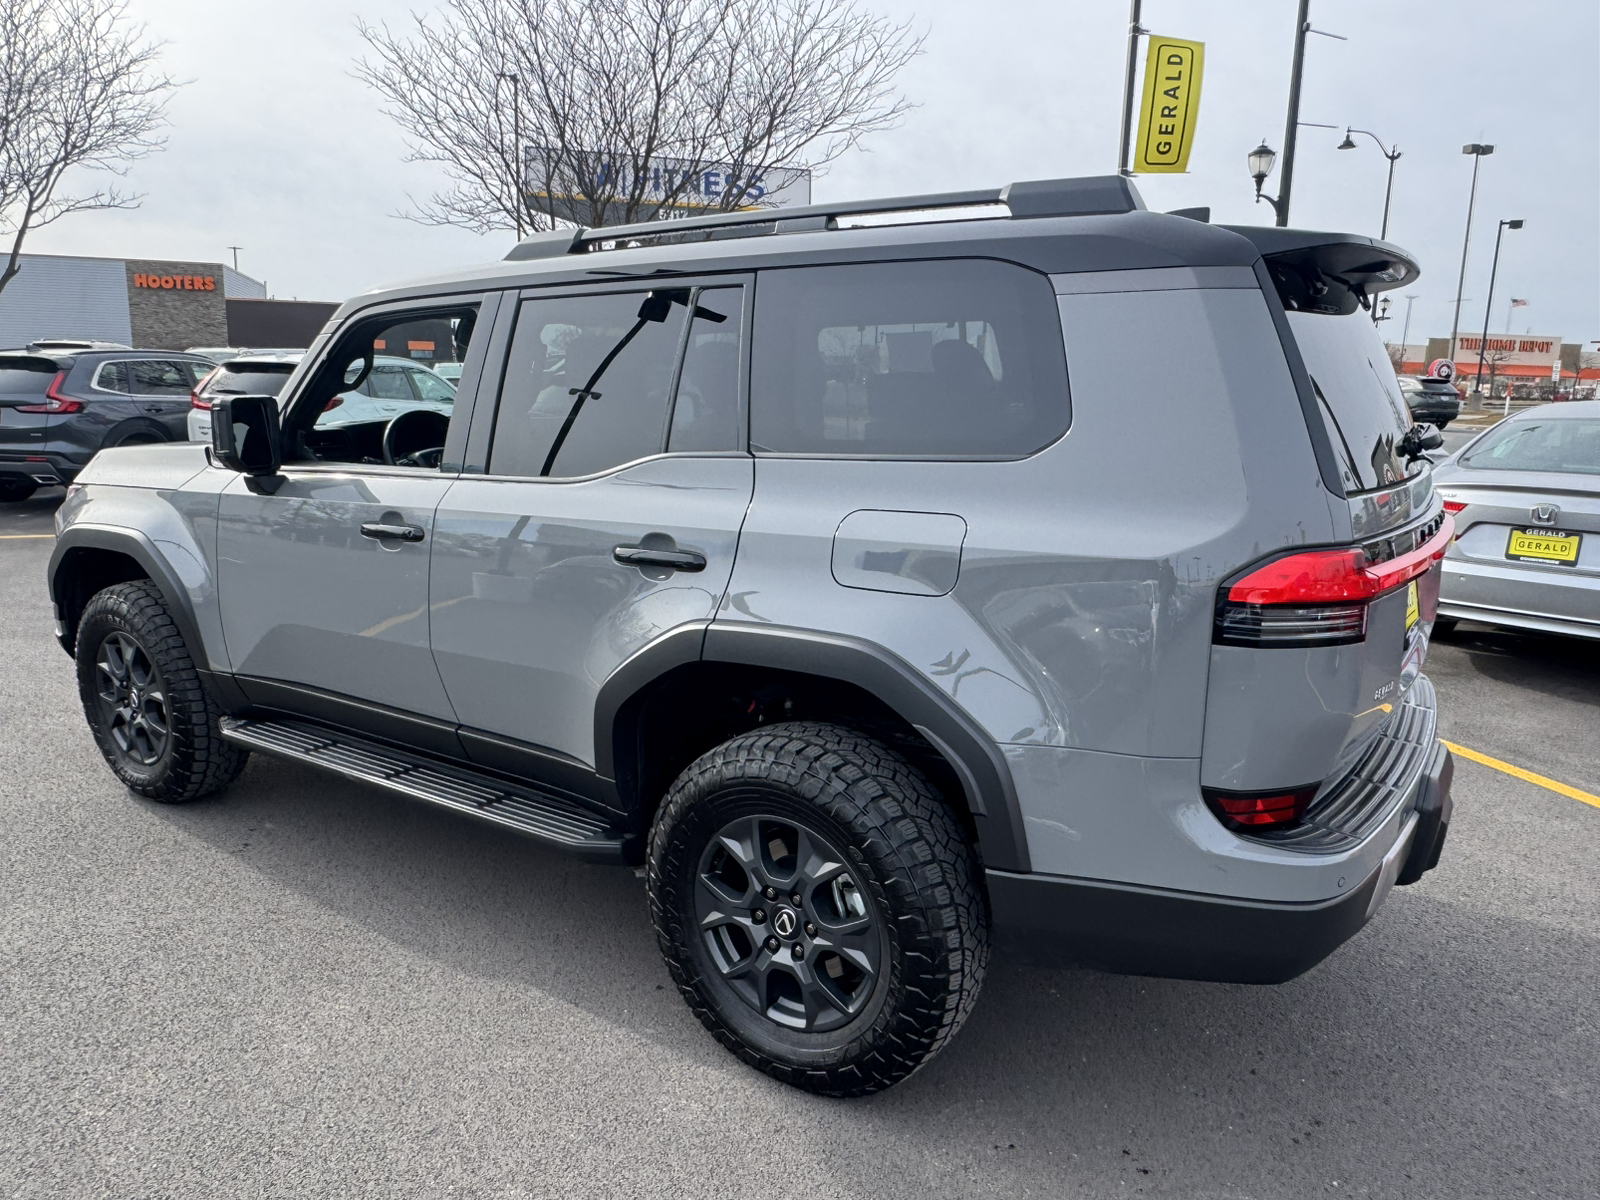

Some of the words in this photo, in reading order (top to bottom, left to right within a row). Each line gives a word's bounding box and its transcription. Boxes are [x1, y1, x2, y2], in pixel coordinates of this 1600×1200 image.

[1156, 54, 1183, 155] GERALD
[637, 164, 766, 200] ITNESS
[134, 273, 215, 291] HOOTERS
[1459, 337, 1482, 350] THE
[1484, 338, 1517, 352] HOME
[1518, 340, 1553, 353] DEPOT
[1525, 528, 1566, 539] GERALD
[1518, 541, 1568, 552] GERALD
